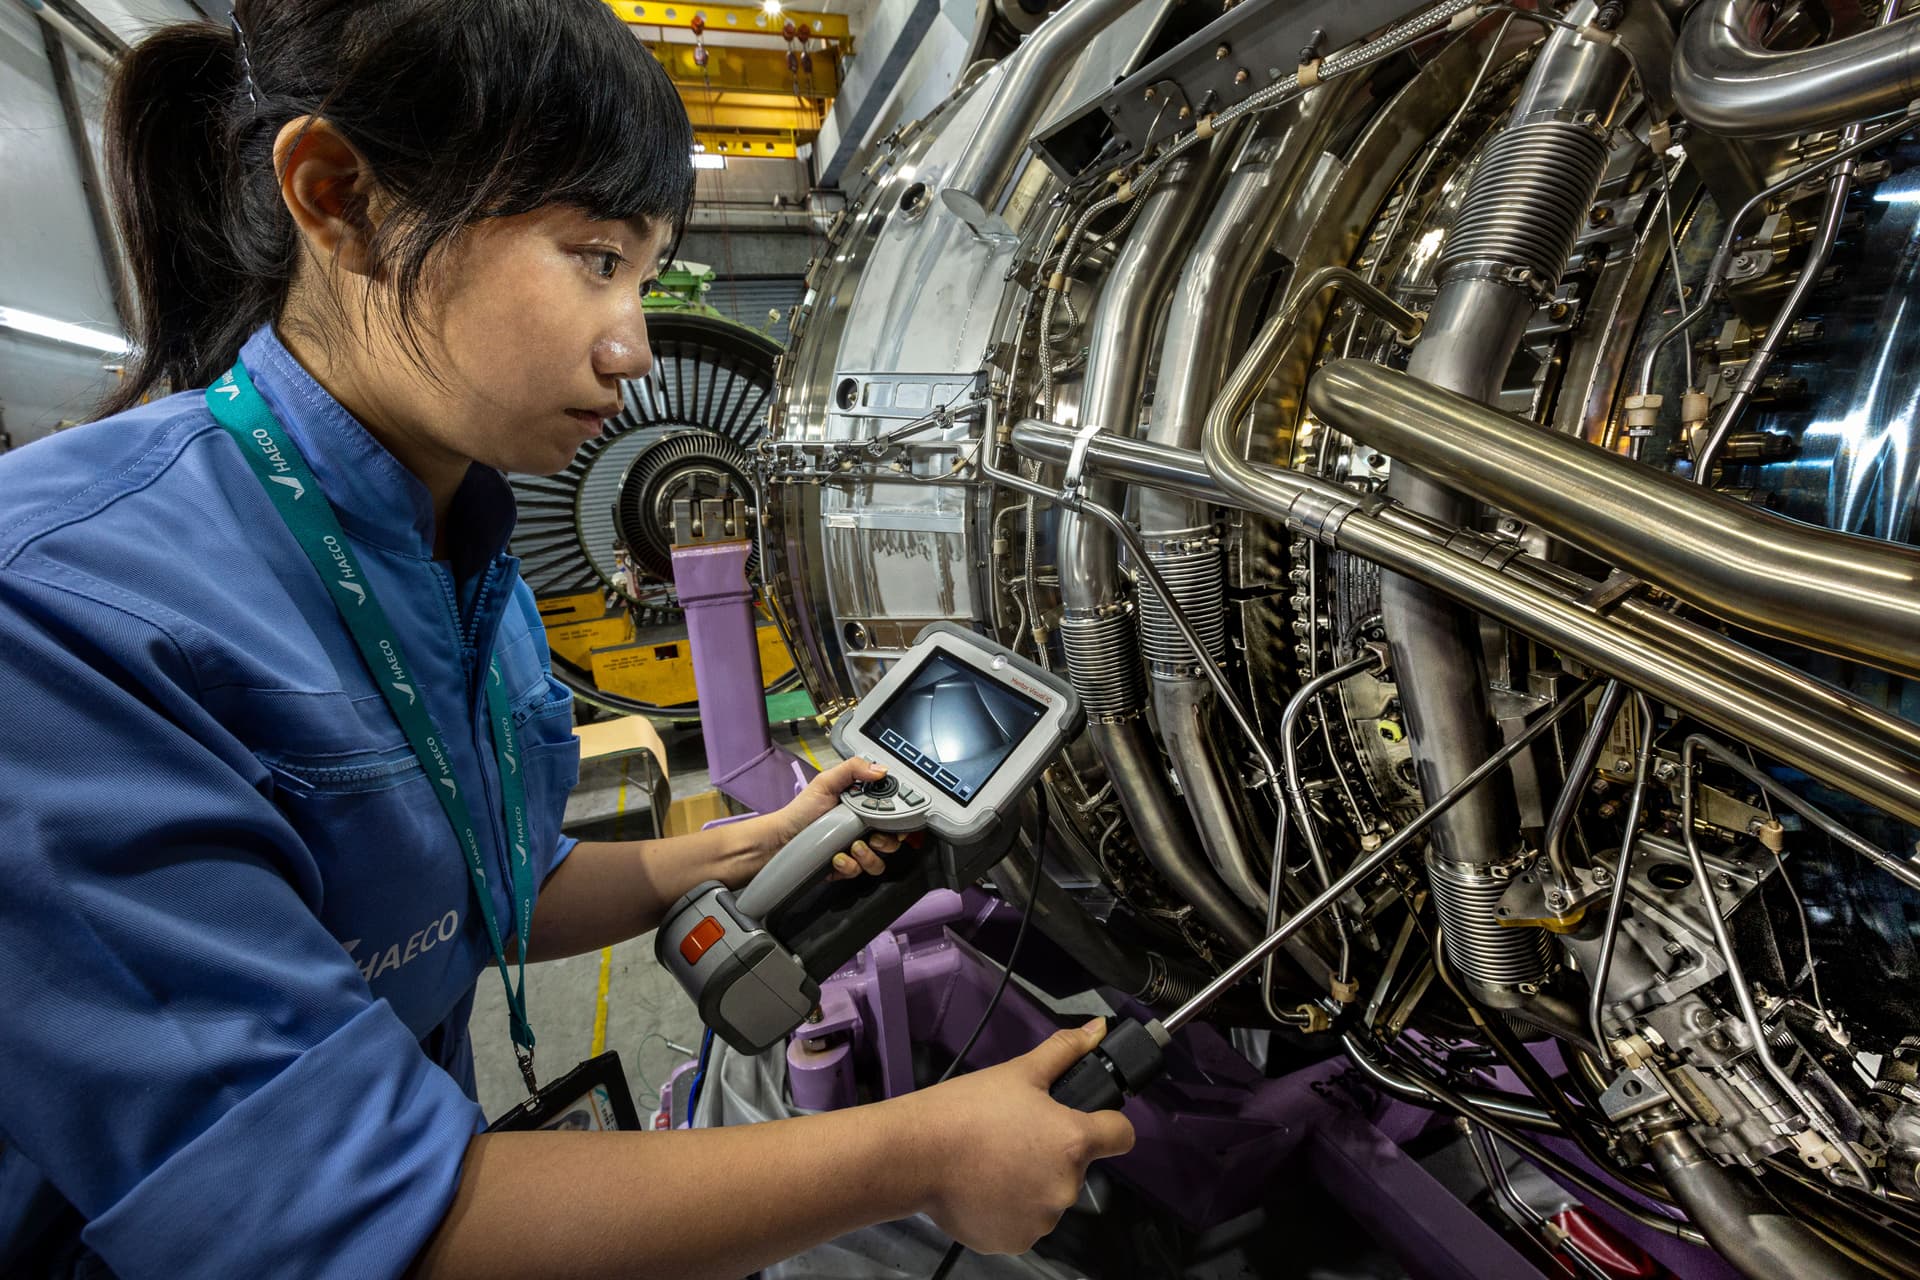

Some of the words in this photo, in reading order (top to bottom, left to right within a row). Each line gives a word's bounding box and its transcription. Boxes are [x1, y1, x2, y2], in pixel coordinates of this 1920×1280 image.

[252, 428, 291, 473] HAECO
[323, 535, 356, 578] HAECO
[379, 639, 406, 680] HAECO
[502, 717, 514, 753] HAECO
[426, 736, 450, 776] HAECO
[515, 806, 524, 843] HAECO
